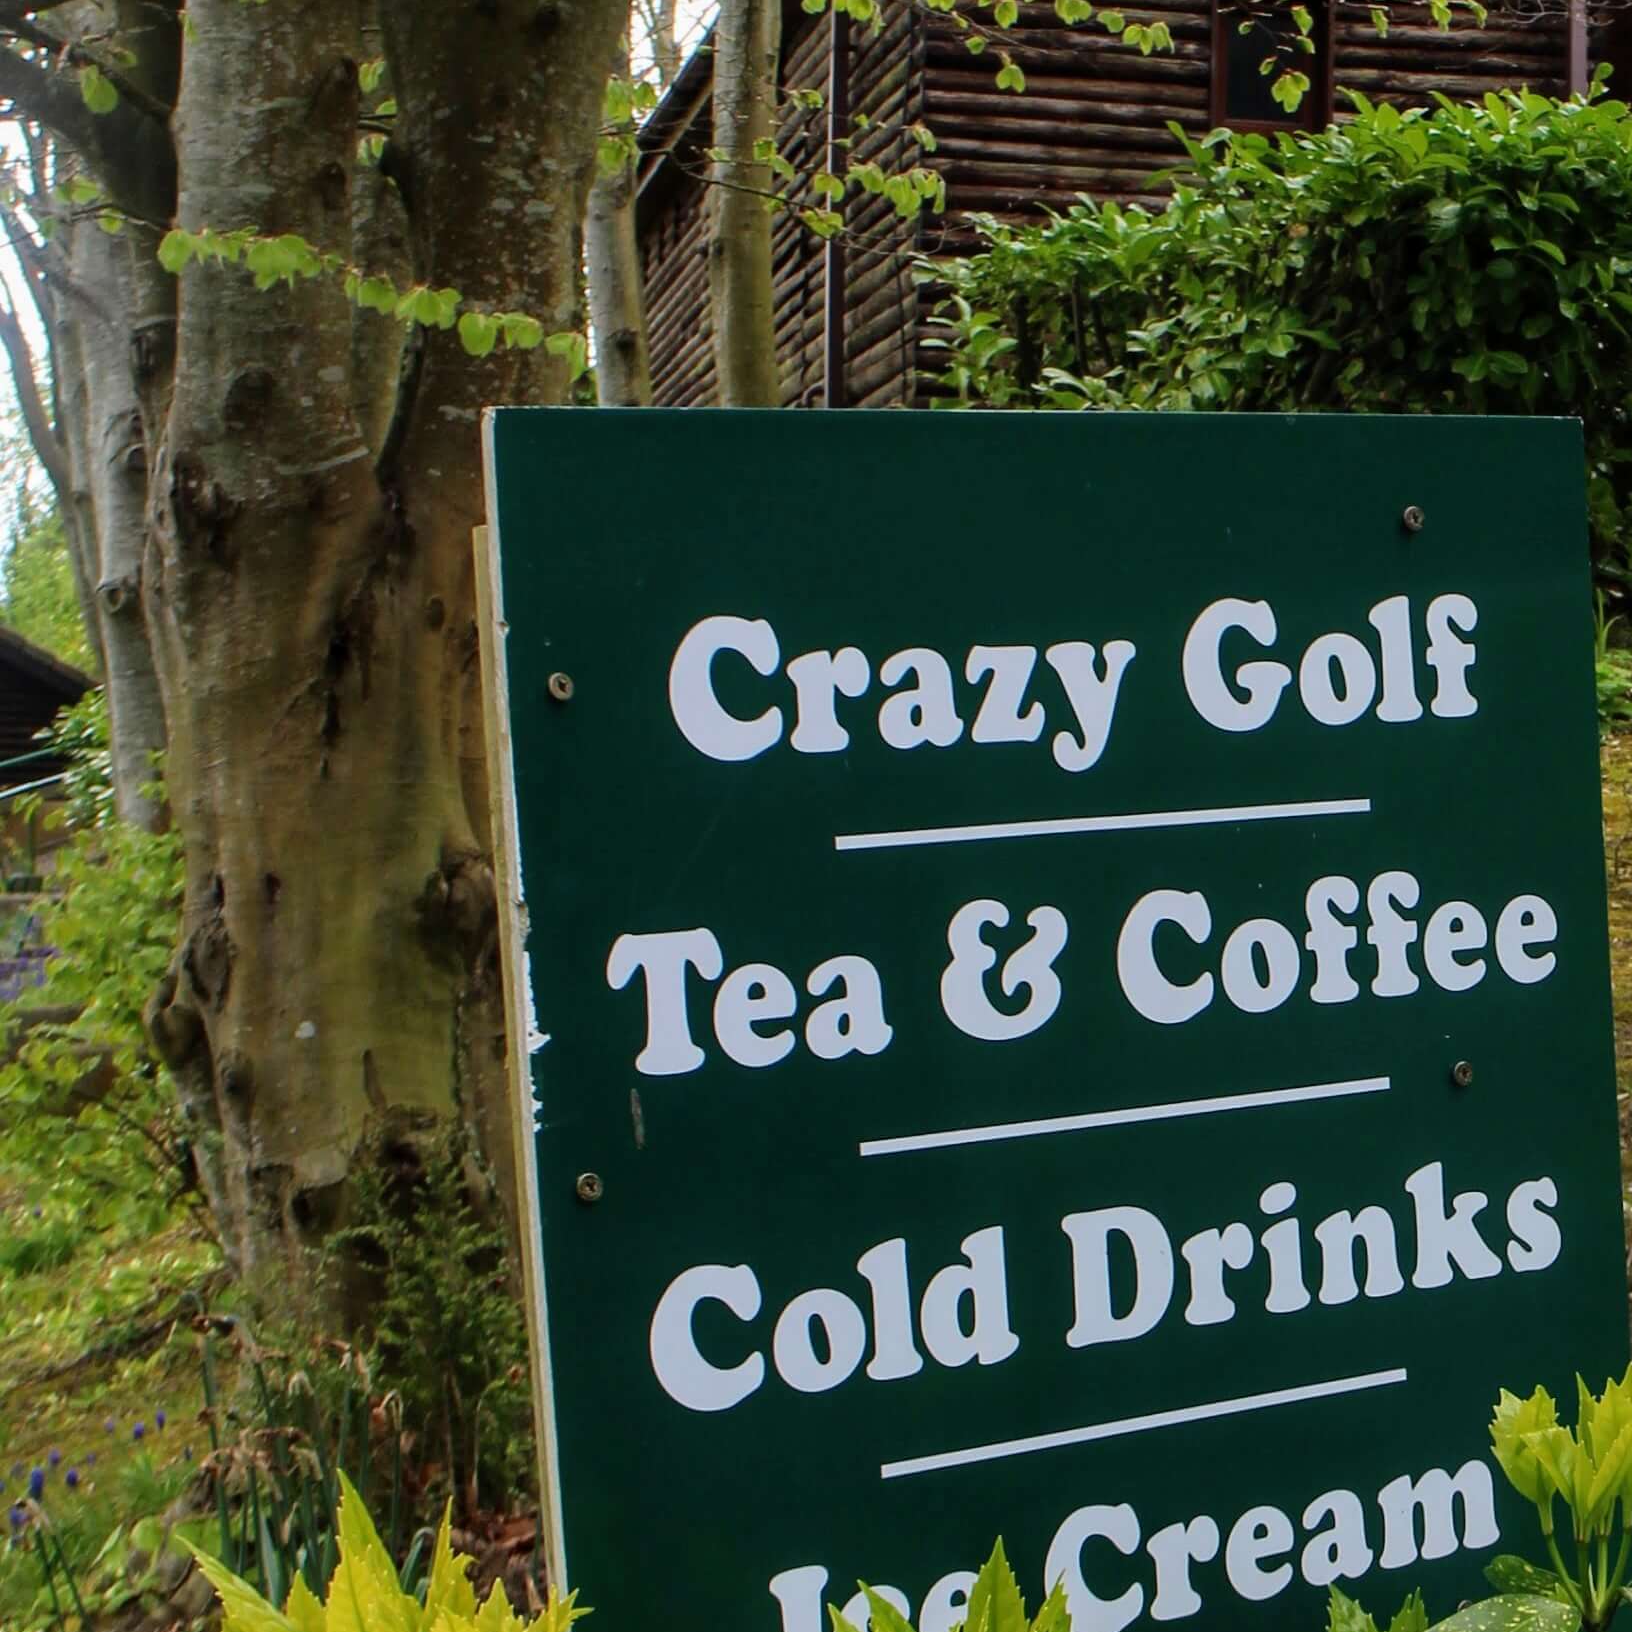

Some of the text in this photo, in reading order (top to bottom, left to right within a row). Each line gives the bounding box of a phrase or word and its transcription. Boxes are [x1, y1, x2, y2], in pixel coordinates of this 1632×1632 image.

[669, 593, 1478, 772] Crazy Golf
[606, 871, 1559, 1076] Tea & Coffee
[650, 1161, 1563, 1412] Cold Drinks
